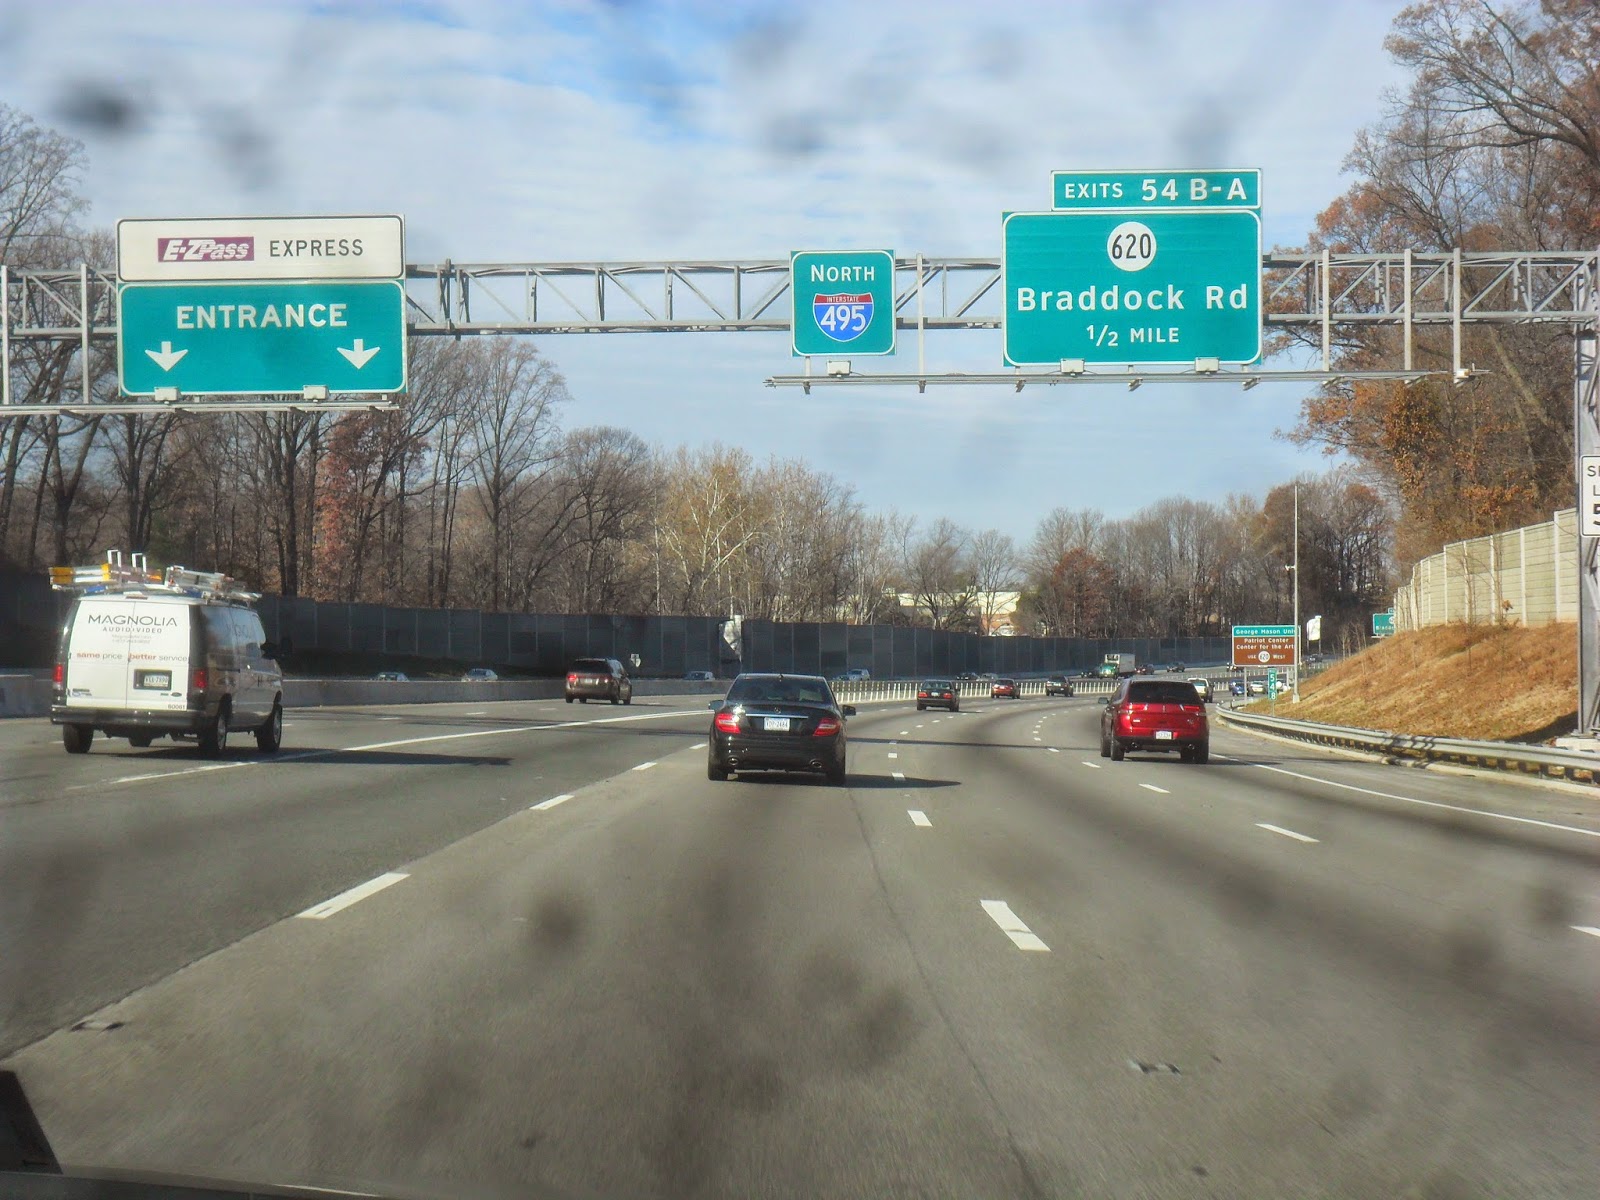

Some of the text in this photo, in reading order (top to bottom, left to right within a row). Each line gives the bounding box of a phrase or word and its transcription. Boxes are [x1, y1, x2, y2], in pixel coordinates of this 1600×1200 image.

[1065, 183, 1123, 198] EXITS
[1141, 179, 1179, 201] 54
[162, 239, 363, 261] E-ZPass EXPRESS
[1112, 233, 1151, 260] 620
[811, 264, 875, 282] NORTH
[1017, 283, 1247, 311] Braddock Rd
[176, 303, 348, 329] ENTRANCE
[820, 305, 867, 332] 495
[1086, 324, 1180, 347] 1/2 MILE
[88, 614, 178, 627] MAGNOLIA
[102, 652, 123, 660] price
[129, 652, 157, 660] better
[159, 654, 188, 662] service
